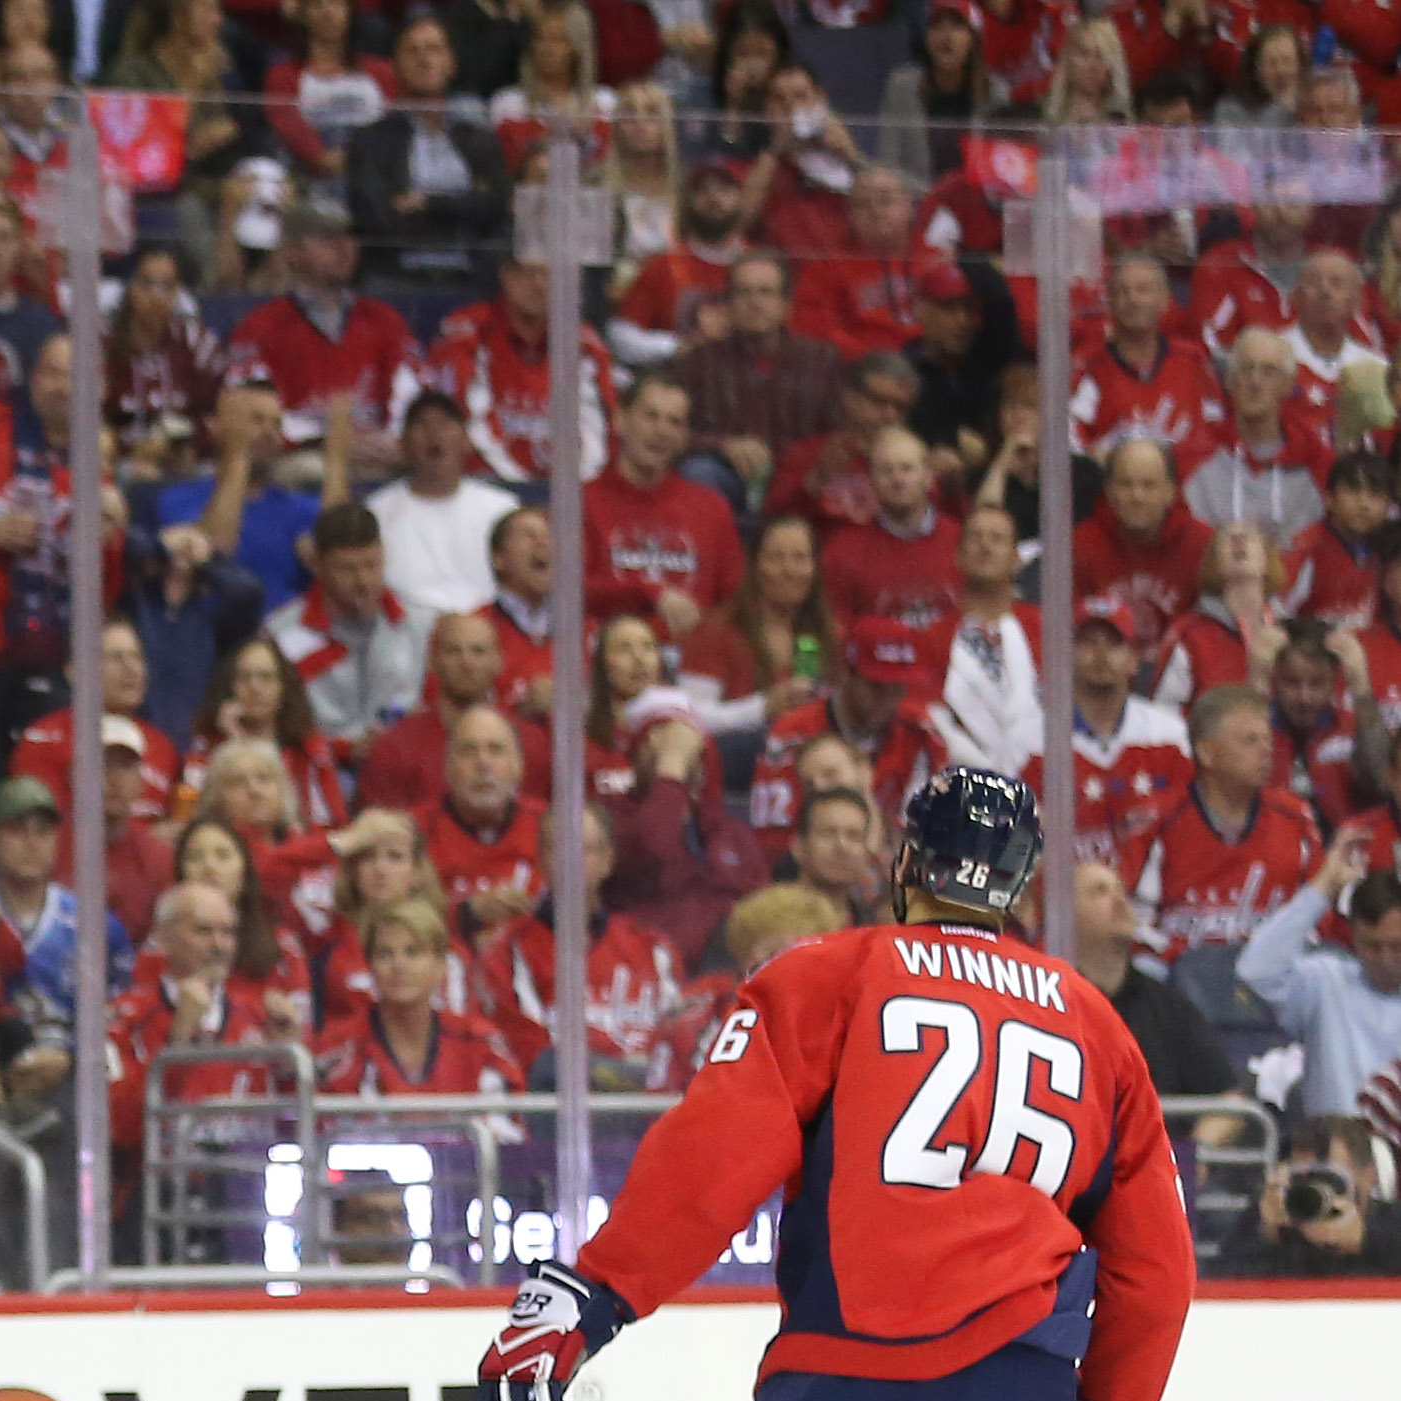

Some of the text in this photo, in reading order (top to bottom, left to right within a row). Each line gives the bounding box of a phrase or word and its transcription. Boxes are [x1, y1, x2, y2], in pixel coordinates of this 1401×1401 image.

[955, 857, 991, 889] 26
[894, 936, 1067, 1014] WINNIK
[880, 994, 1083, 1201] 26
